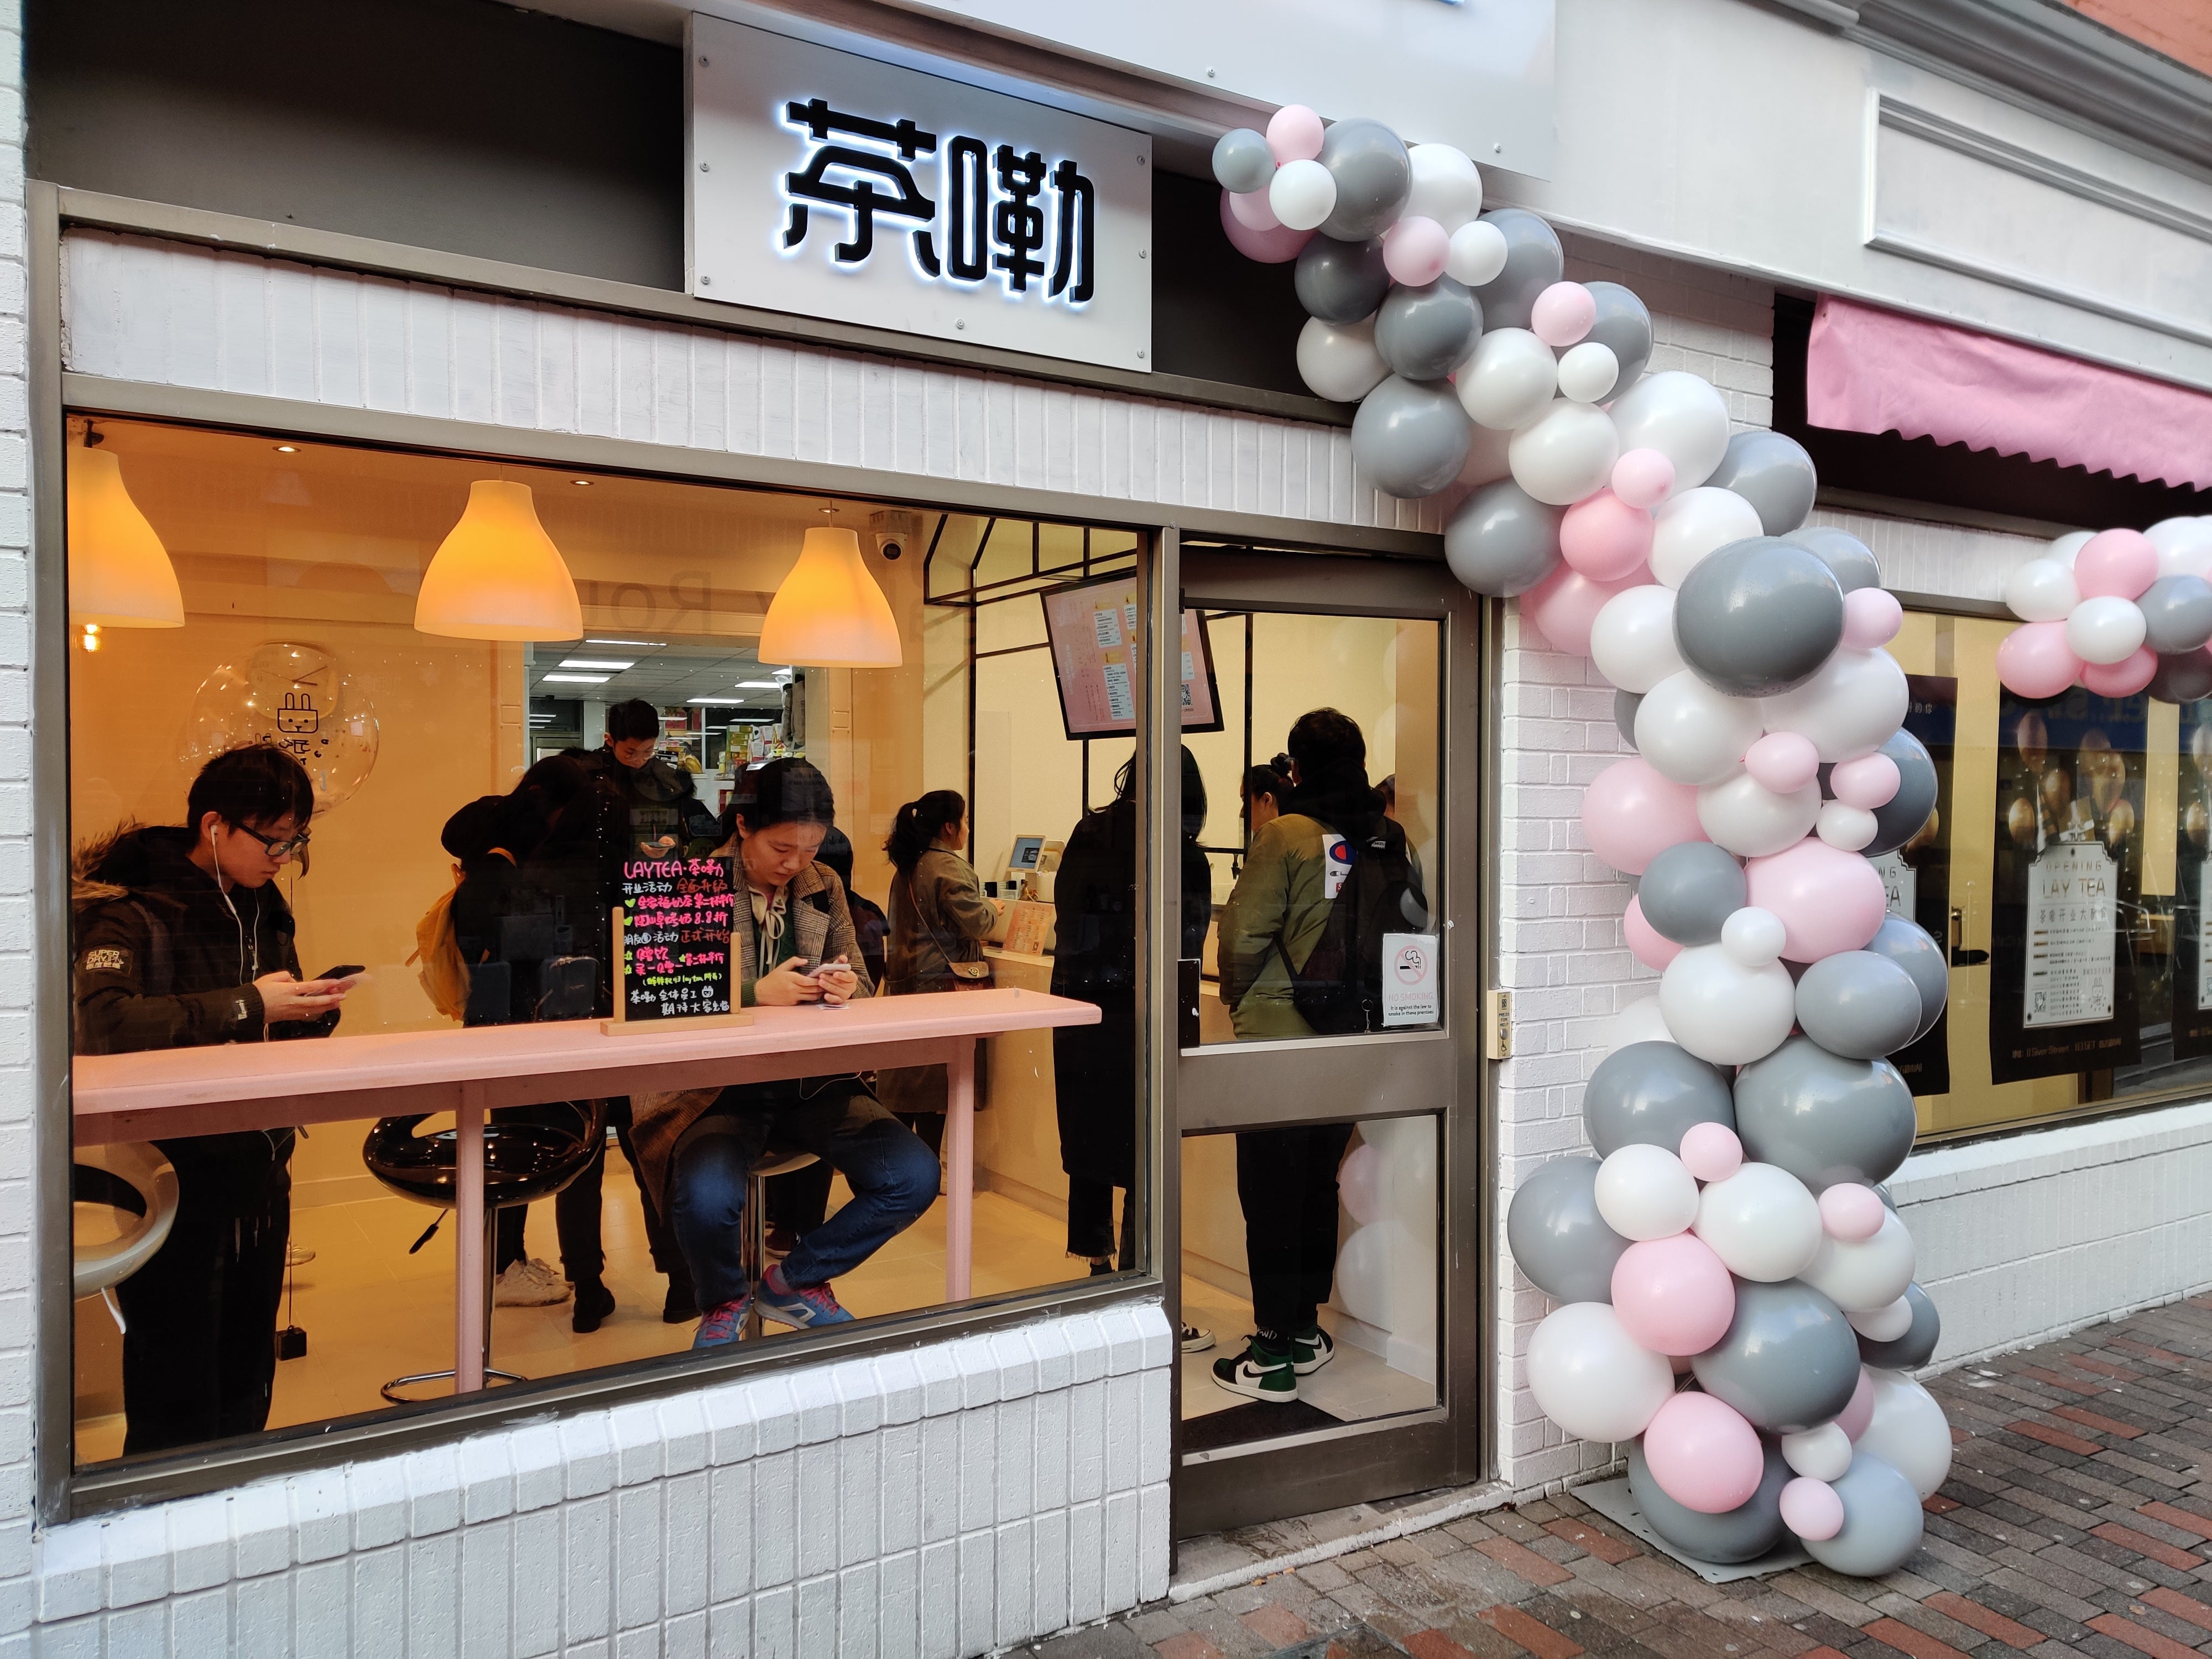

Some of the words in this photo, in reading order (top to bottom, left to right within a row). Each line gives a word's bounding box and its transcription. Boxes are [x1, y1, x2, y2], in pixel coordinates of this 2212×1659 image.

[782, 98, 1095, 303] 茶嘞
[2046, 860, 2101, 872] OPENING
[622, 881, 672, 895] 开业活动
[2043, 879, 2070, 899] LAY
[2078, 878, 2106, 898] TEA
